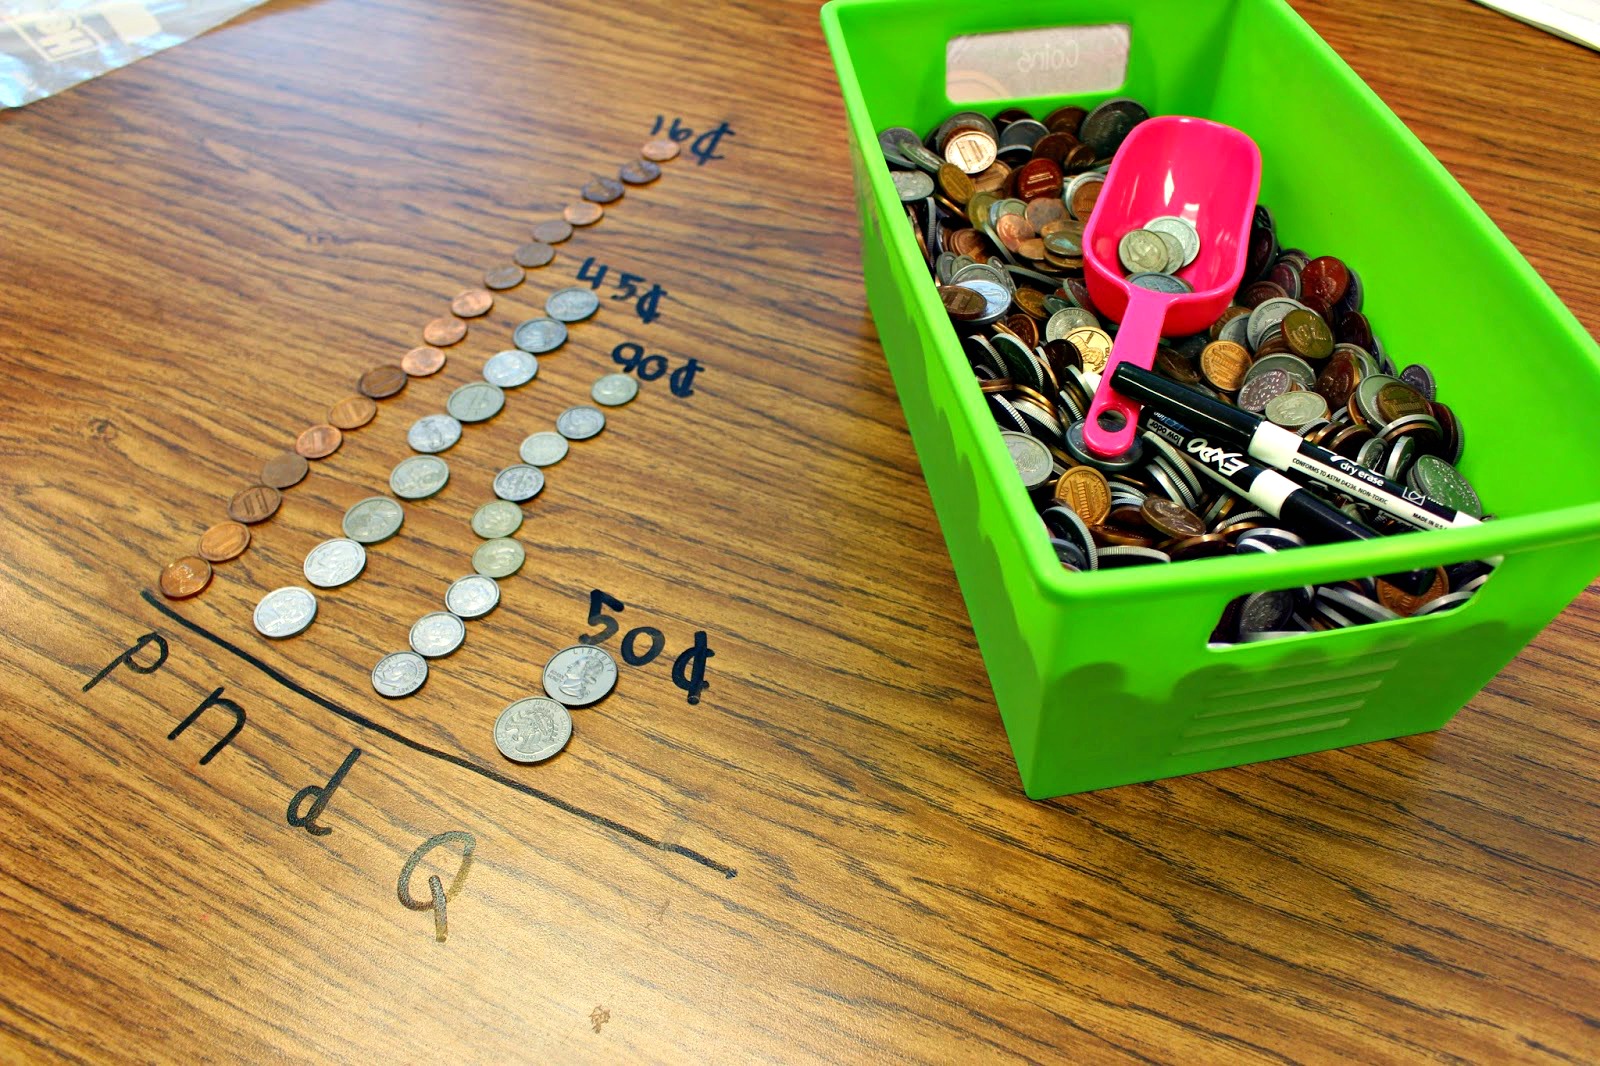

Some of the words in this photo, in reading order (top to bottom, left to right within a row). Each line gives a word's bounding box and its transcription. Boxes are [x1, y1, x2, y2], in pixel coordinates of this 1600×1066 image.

[651, 115, 736, 166] 16¢
[576, 257, 668, 324] 45¢
[611, 342, 705, 398] 90¢
[1150, 421, 1167, 433] odor
[1167, 431, 1182, 444] low
[1186, 438, 1250, 477] EXPO
[1340, 462, 1358, 475] dry
[1358, 470, 1385, 487] erase
[1292, 458, 1320, 474] CONFORMS
[1326, 473, 1340, 482] ASTM
[1358, 487, 1388, 505] NON-TOXIC
[1412, 513, 1428, 523] MADE
[578, 589, 715, 704] 50¢
[287, 748, 362, 835] d
